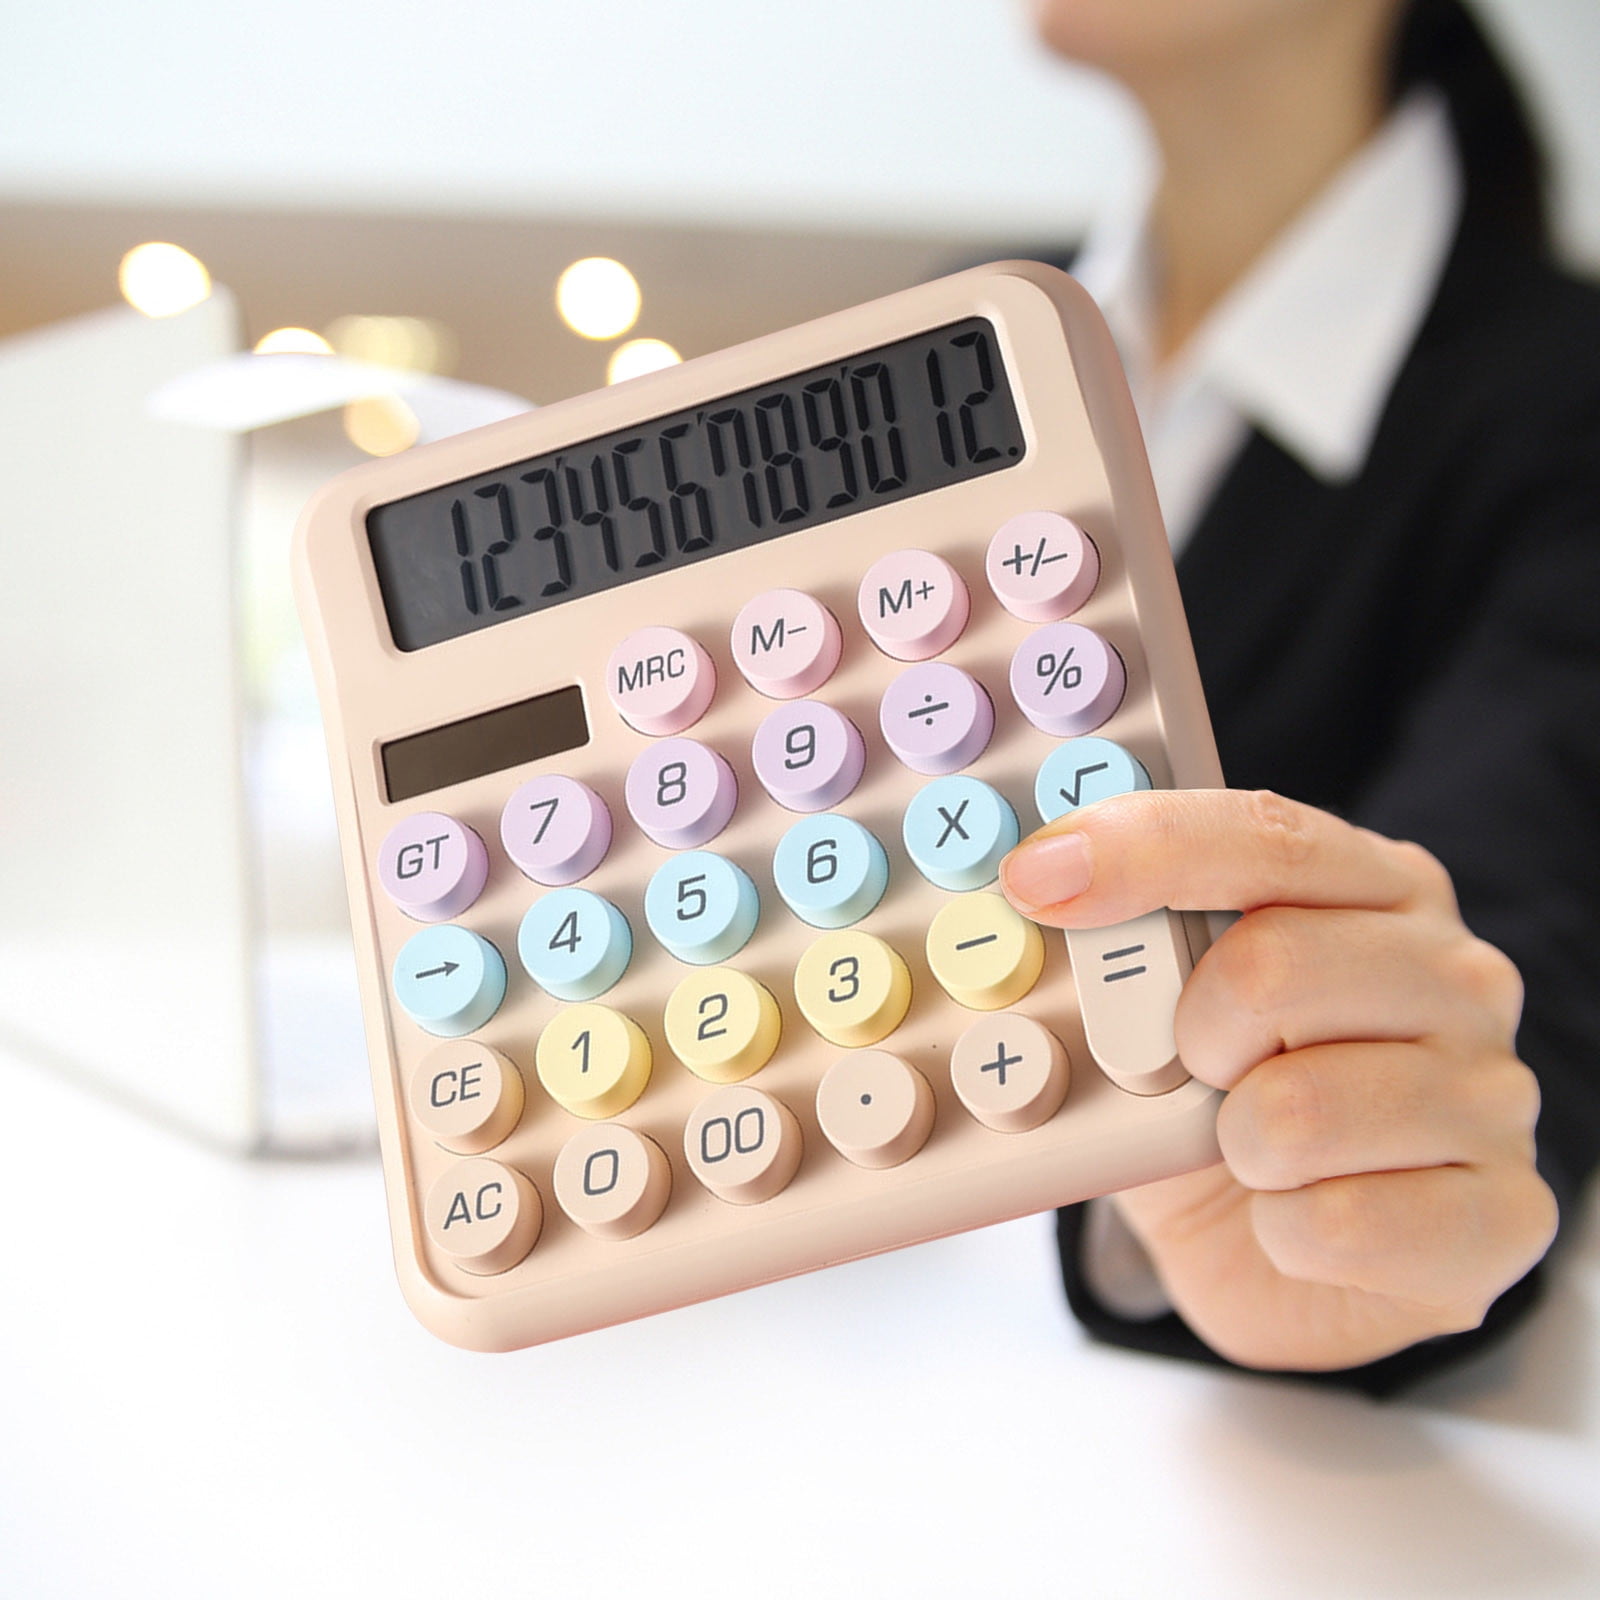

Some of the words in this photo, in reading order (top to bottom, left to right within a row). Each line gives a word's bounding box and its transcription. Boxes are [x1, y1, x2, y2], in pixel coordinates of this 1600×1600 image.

[879, 579, 935, 618] M+
[618, 648, 685, 694] MRC
[1036, 647, 1082, 696] %
[784, 725, 816, 770] 9
[657, 762, 687, 807] 8
[530, 798, 560, 846] 7
[397, 834, 450, 880] GT
[807, 839, 837, 884] 6
[677, 874, 707, 921] 5
[548, 911, 582, 953] 4
[828, 956, 859, 1003] 3
[697, 993, 728, 1041] 2
[571, 1030, 590, 1073] 1
[430, 1063, 482, 1108] CE
[583, 1149, 619, 1196] 0
[443, 1182, 502, 1230] AC
